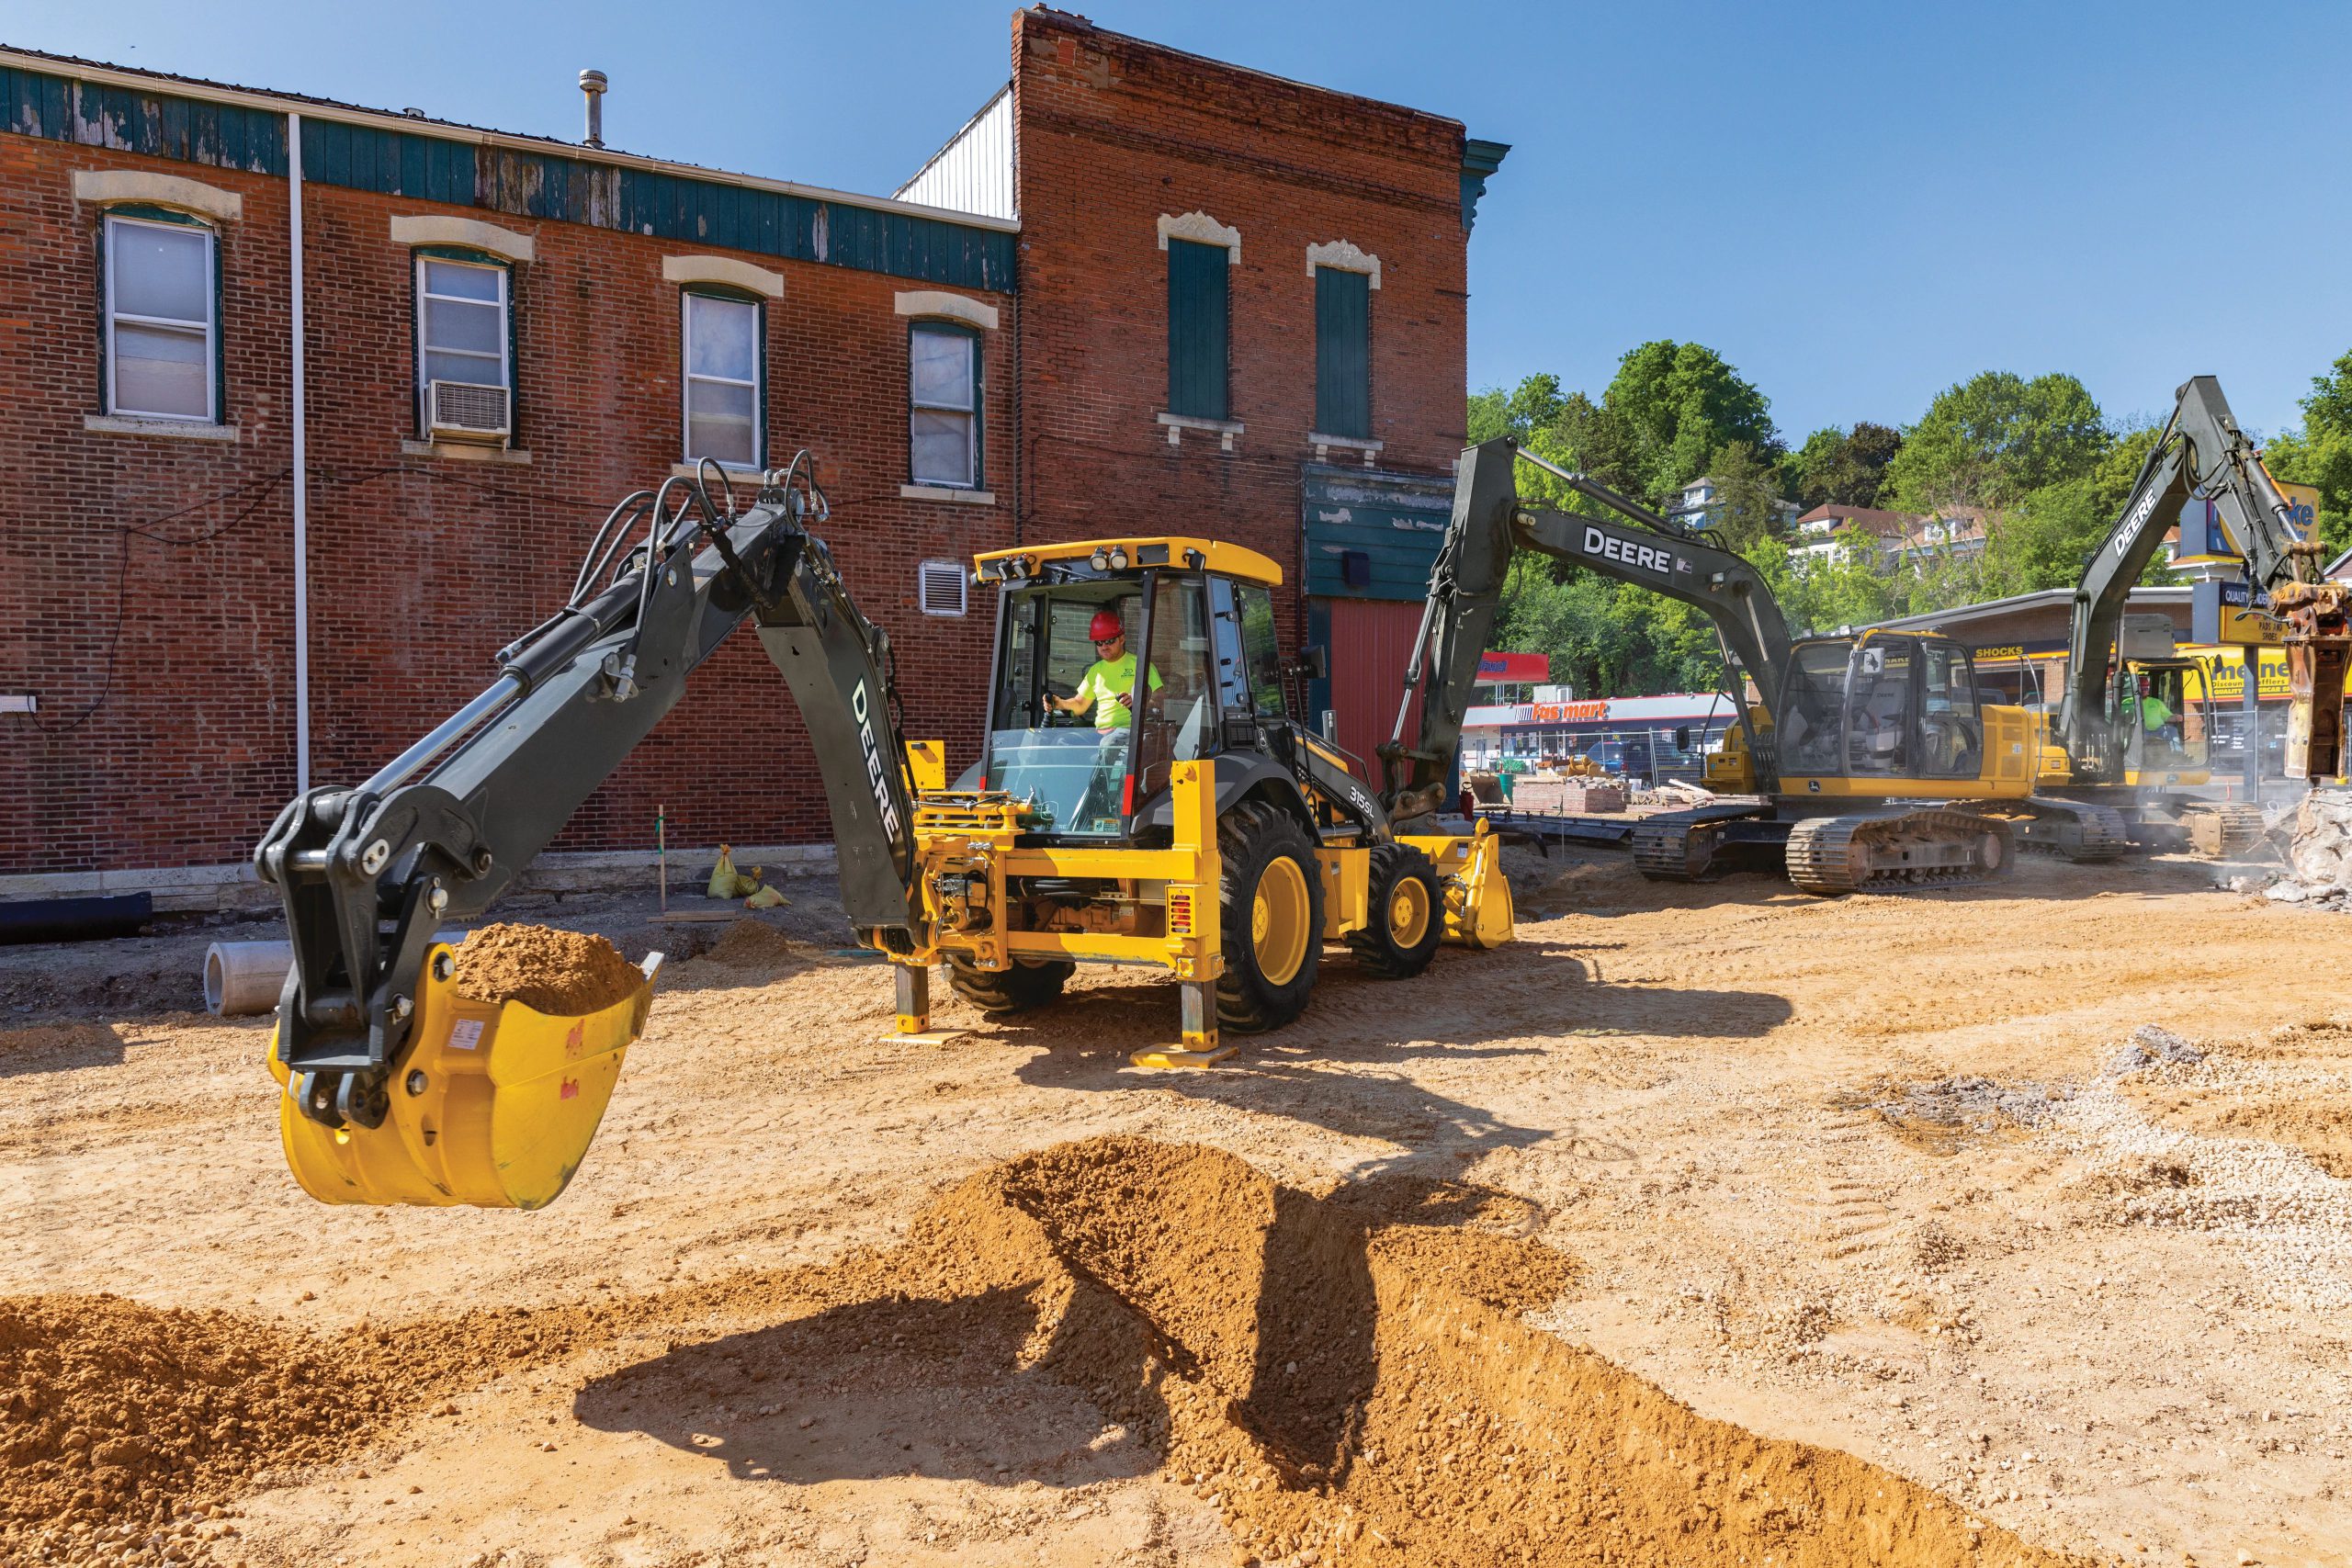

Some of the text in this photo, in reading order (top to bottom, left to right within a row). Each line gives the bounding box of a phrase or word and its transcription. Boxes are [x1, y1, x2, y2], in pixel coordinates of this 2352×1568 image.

[2114, 488, 2156, 557] DEERE
[1583, 526, 1671, 573] DEERE
[2225, 591, 2249, 604] QUALITY
[1976, 647, 2023, 658] SHOCKS
[853, 677, 899, 845] DEERE
[1350, 786, 1374, 818] 315SL
